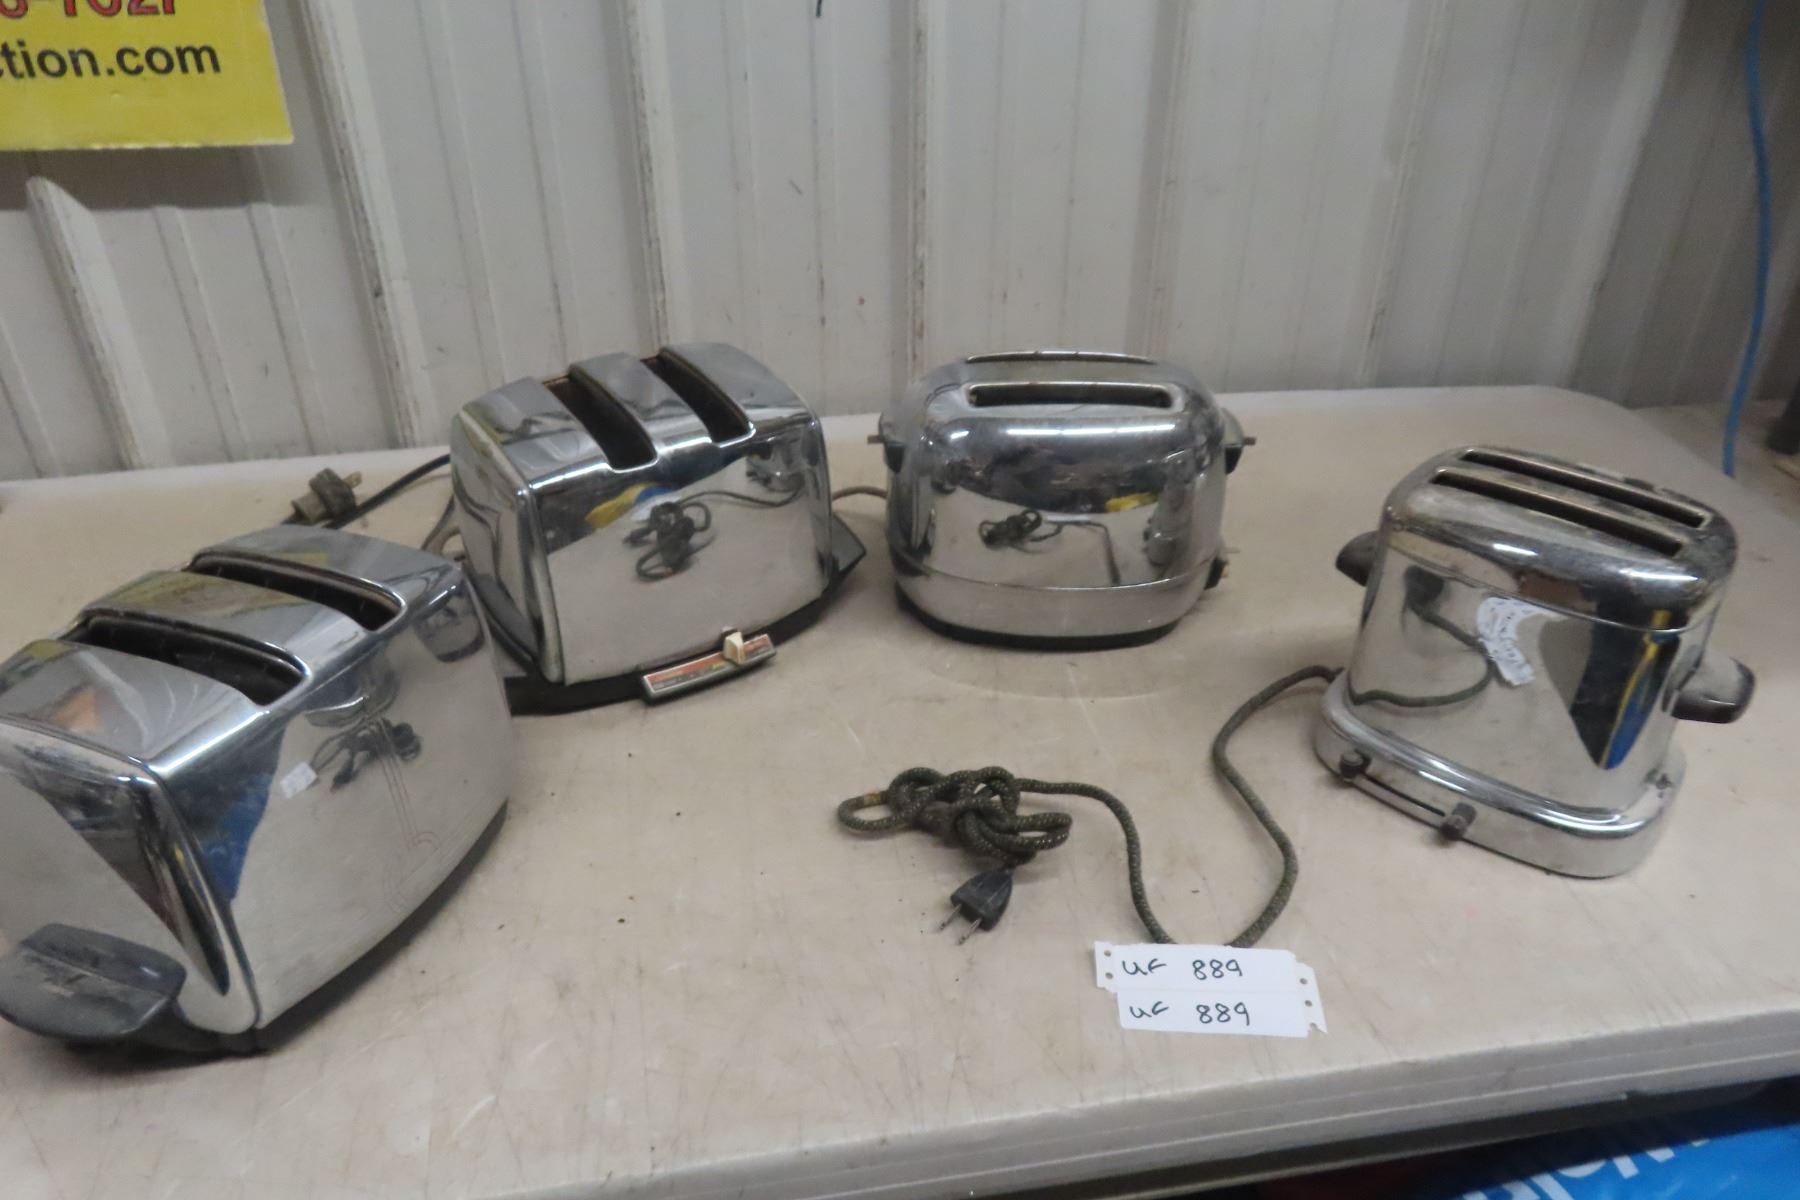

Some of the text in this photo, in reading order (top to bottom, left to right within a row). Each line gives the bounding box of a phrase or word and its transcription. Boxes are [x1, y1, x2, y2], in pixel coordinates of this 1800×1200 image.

[0, 39, 221, 79] tion.com
[1192, 958, 1243, 981] 889
[1195, 1001, 1250, 1027] 889
